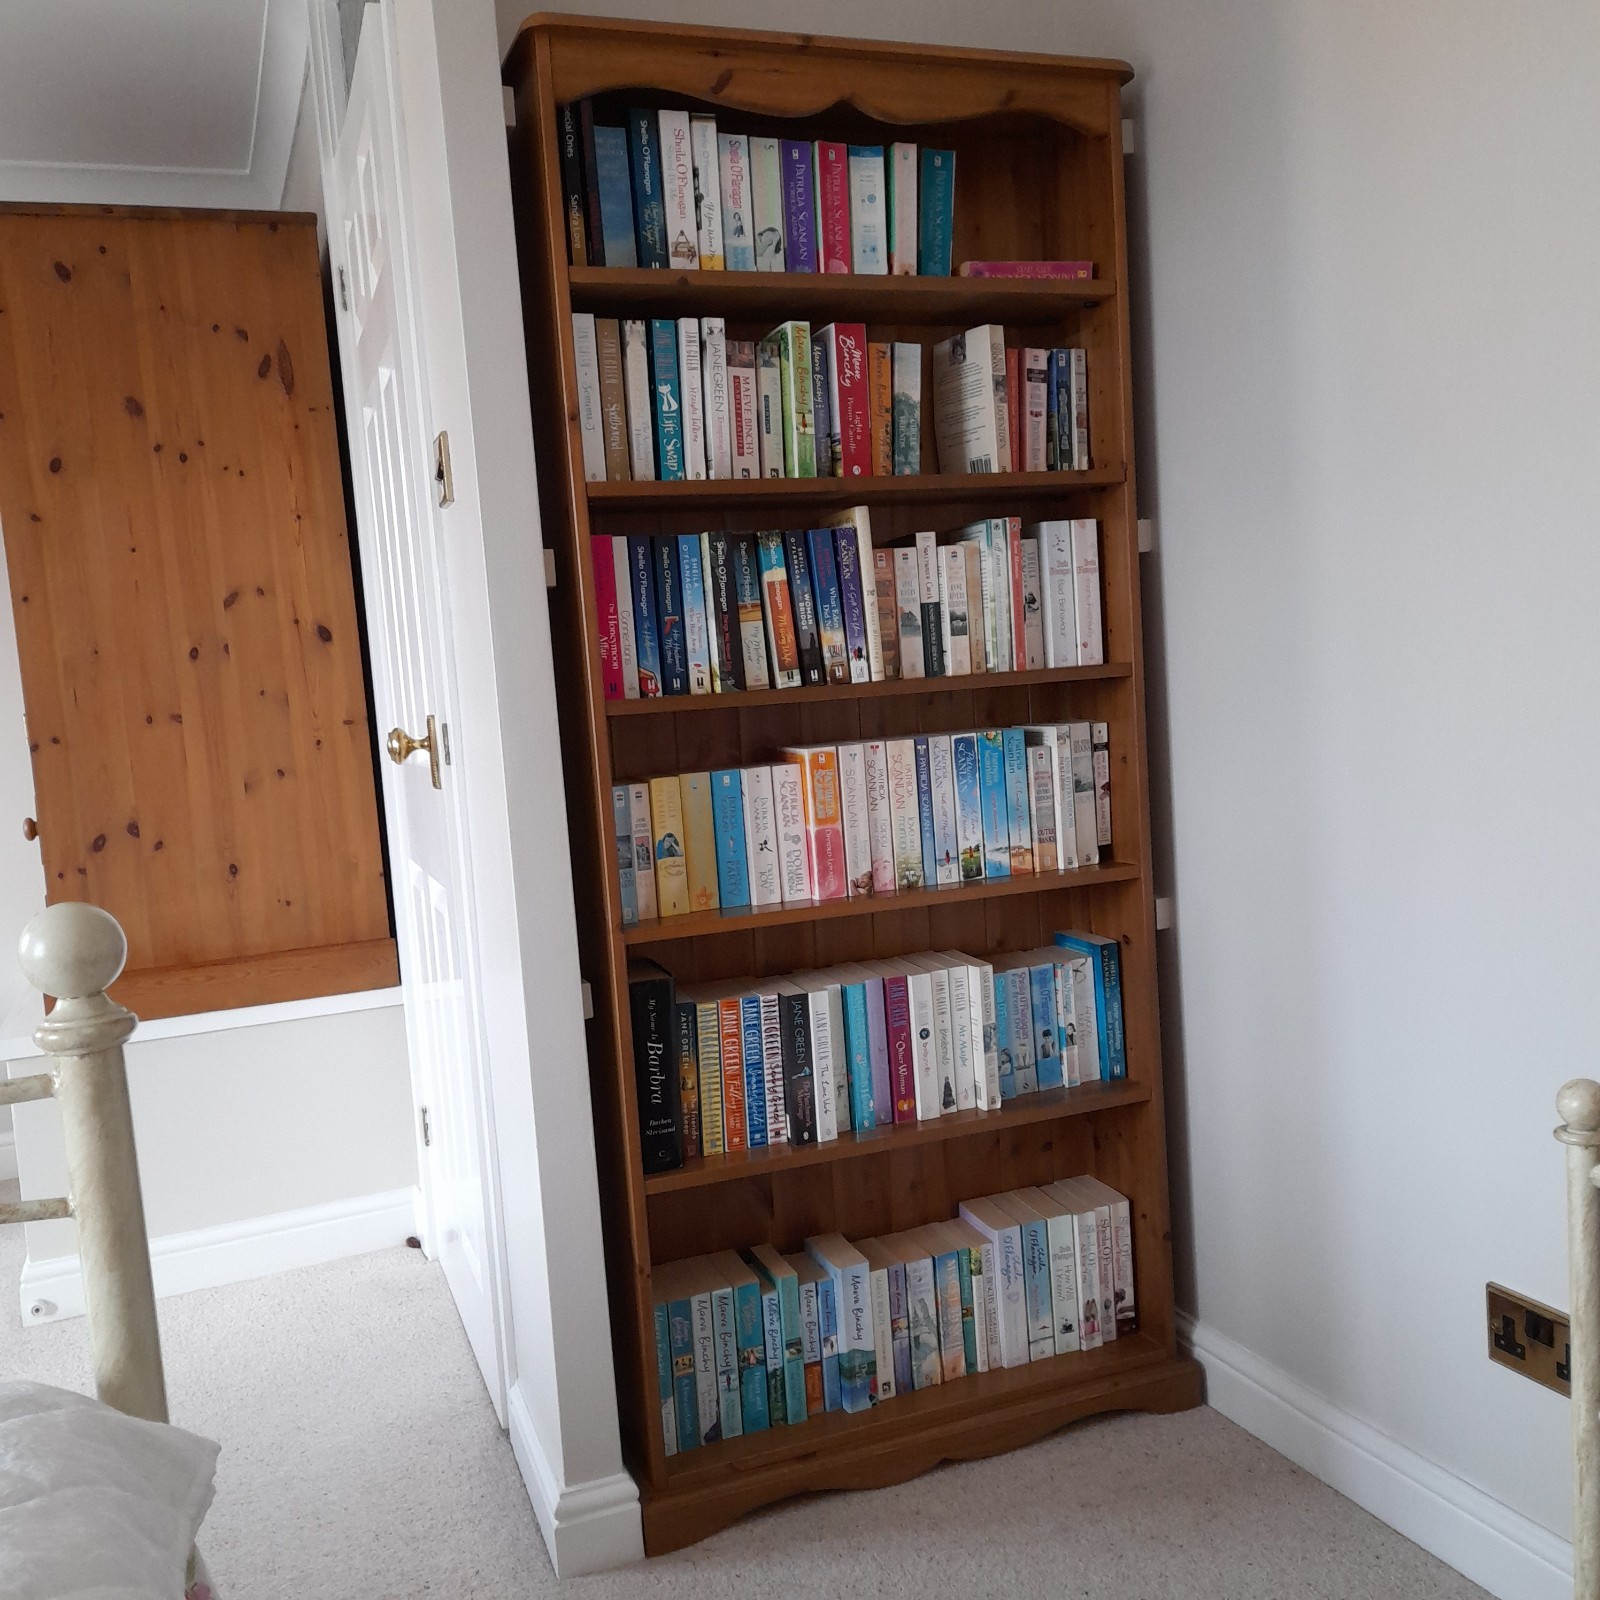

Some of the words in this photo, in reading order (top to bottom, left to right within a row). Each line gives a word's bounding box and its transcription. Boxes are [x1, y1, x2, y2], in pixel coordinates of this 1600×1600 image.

[565, 134, 574, 158] Ones
[673, 128, 686, 162] Sheila
[729, 140, 741, 164] Sheila
[676, 164, 688, 219] O'Flanagan
[731, 166, 743, 208] O'Flanagan
[795, 164, 806, 206] PATRICIA
[570, 194, 582, 225] Sandra
[573, 227, 581, 248] Love
[799, 212, 808, 260] SCANLAN
[685, 331, 698, 349] JANE
[686, 350, 698, 371] GREEN
[711, 343, 723, 370] JANE
[840, 335, 854, 386] Binchy
[852, 349, 862, 381] Maeve
[713, 370, 724, 412] GREEN
[742, 376, 752, 414] MAEVE
[797, 367, 808, 405] Binchy
[814, 374, 823, 403] Binchy
[661, 412, 676, 433] Life
[745, 419, 753, 456] BINCHY
[997, 405, 1005, 449] DOWNTOWN
[663, 439, 680, 470] Swap
[637, 546, 646, 569] Sheila
[662, 546, 670, 568] Sheila
[716, 542, 725, 564] Sheila
[790, 537, 800, 584] O'FLANAGAN
[840, 539, 850, 580] SCANLAN
[994, 543, 1002, 553] off
[682, 545, 691, 602] O'FLANAGAN
[691, 558, 700, 588] SHEILA
[742, 566, 752, 611] O'Flanagan
[639, 571, 648, 617] O'Flanagan
[664, 570, 673, 613] O'Flanagan
[719, 567, 728, 612] O'Flanagan
[799, 602, 807, 630] BRIDGE
[805, 593, 813, 625] WOMAN
[608, 615, 619, 669] Honeymoon
[620, 610, 632, 666] Connections
[672, 630, 681, 642] Her
[778, 615, 788, 644] Missing
[780, 646, 791, 666] Wife
[933, 740, 943, 789] SCANLAN
[957, 742, 967, 793] SCANLAN
[966, 750, 974, 783] Patricia
[984, 749, 993, 786] Scanlan
[991, 752, 999, 782] Patricia
[1007, 736, 1016, 773] Scanlan
[867, 760, 878, 811] SCANLAN
[893, 754, 905, 809] SCANLAN
[920, 758, 928, 791] PATRICIA
[780, 780, 790, 827] SCANLAN
[788, 780, 798, 824] PATRICIA
[846, 769, 858, 829] SCANLAN
[793, 849, 804, 894] DOUBLE
[890, 984, 906, 1001] JANE
[936, 980, 946, 998] JANE
[955, 977, 964, 991] JANE
[1017, 972, 1027, 995] Sheila
[648, 999, 656, 1010] My
[744, 1000, 758, 1027] JANE
[762, 998, 777, 1023] JANE
[792, 1000, 804, 1025] JANE
[892, 1004, 908, 1027] GREEN
[937, 999, 947, 1015] GREEN
[956, 993, 966, 1011] GREEN
[1019, 997, 1028, 1039] O'Flanagan
[722, 1008, 737, 1035] JANE
[815, 1011, 827, 1032] JANE
[958, 1024, 966, 1038] Mr
[724, 1039, 740, 1075] GREEN
[746, 1030, 761, 1064] GREEN
[764, 1026, 780, 1060] GREEN
[796, 1028, 806, 1063] GREEN
[818, 1035, 829, 1060] GREEN
[896, 1041, 906, 1064] Other
[959, 1039, 968, 1068] Maybe
[647, 1041, 665, 1105] Barbra
[898, 1064, 908, 1095] Woman
[727, 1076, 741, 1108] Falling
[1100, 1219, 1109, 1246] Sheila
[1002, 1236, 1012, 1289] O'Flanagan
[1028, 1230, 1038, 1278] O'Flanagan
[804, 1289, 814, 1317] Maeve
[851, 1275, 860, 1304] Maeve
[986, 1276, 995, 1304] BINCHY
[695, 1300, 708, 1331] Maeve
[718, 1296, 729, 1327] Maeve
[768, 1298, 780, 1326] Maeve
[852, 1308, 864, 1341] Binchy
[719, 1332, 731, 1368] Binchy
[768, 1329, 781, 1360] Binchy
[806, 1321, 816, 1353] Binchy
[697, 1337, 710, 1373] Binchy
